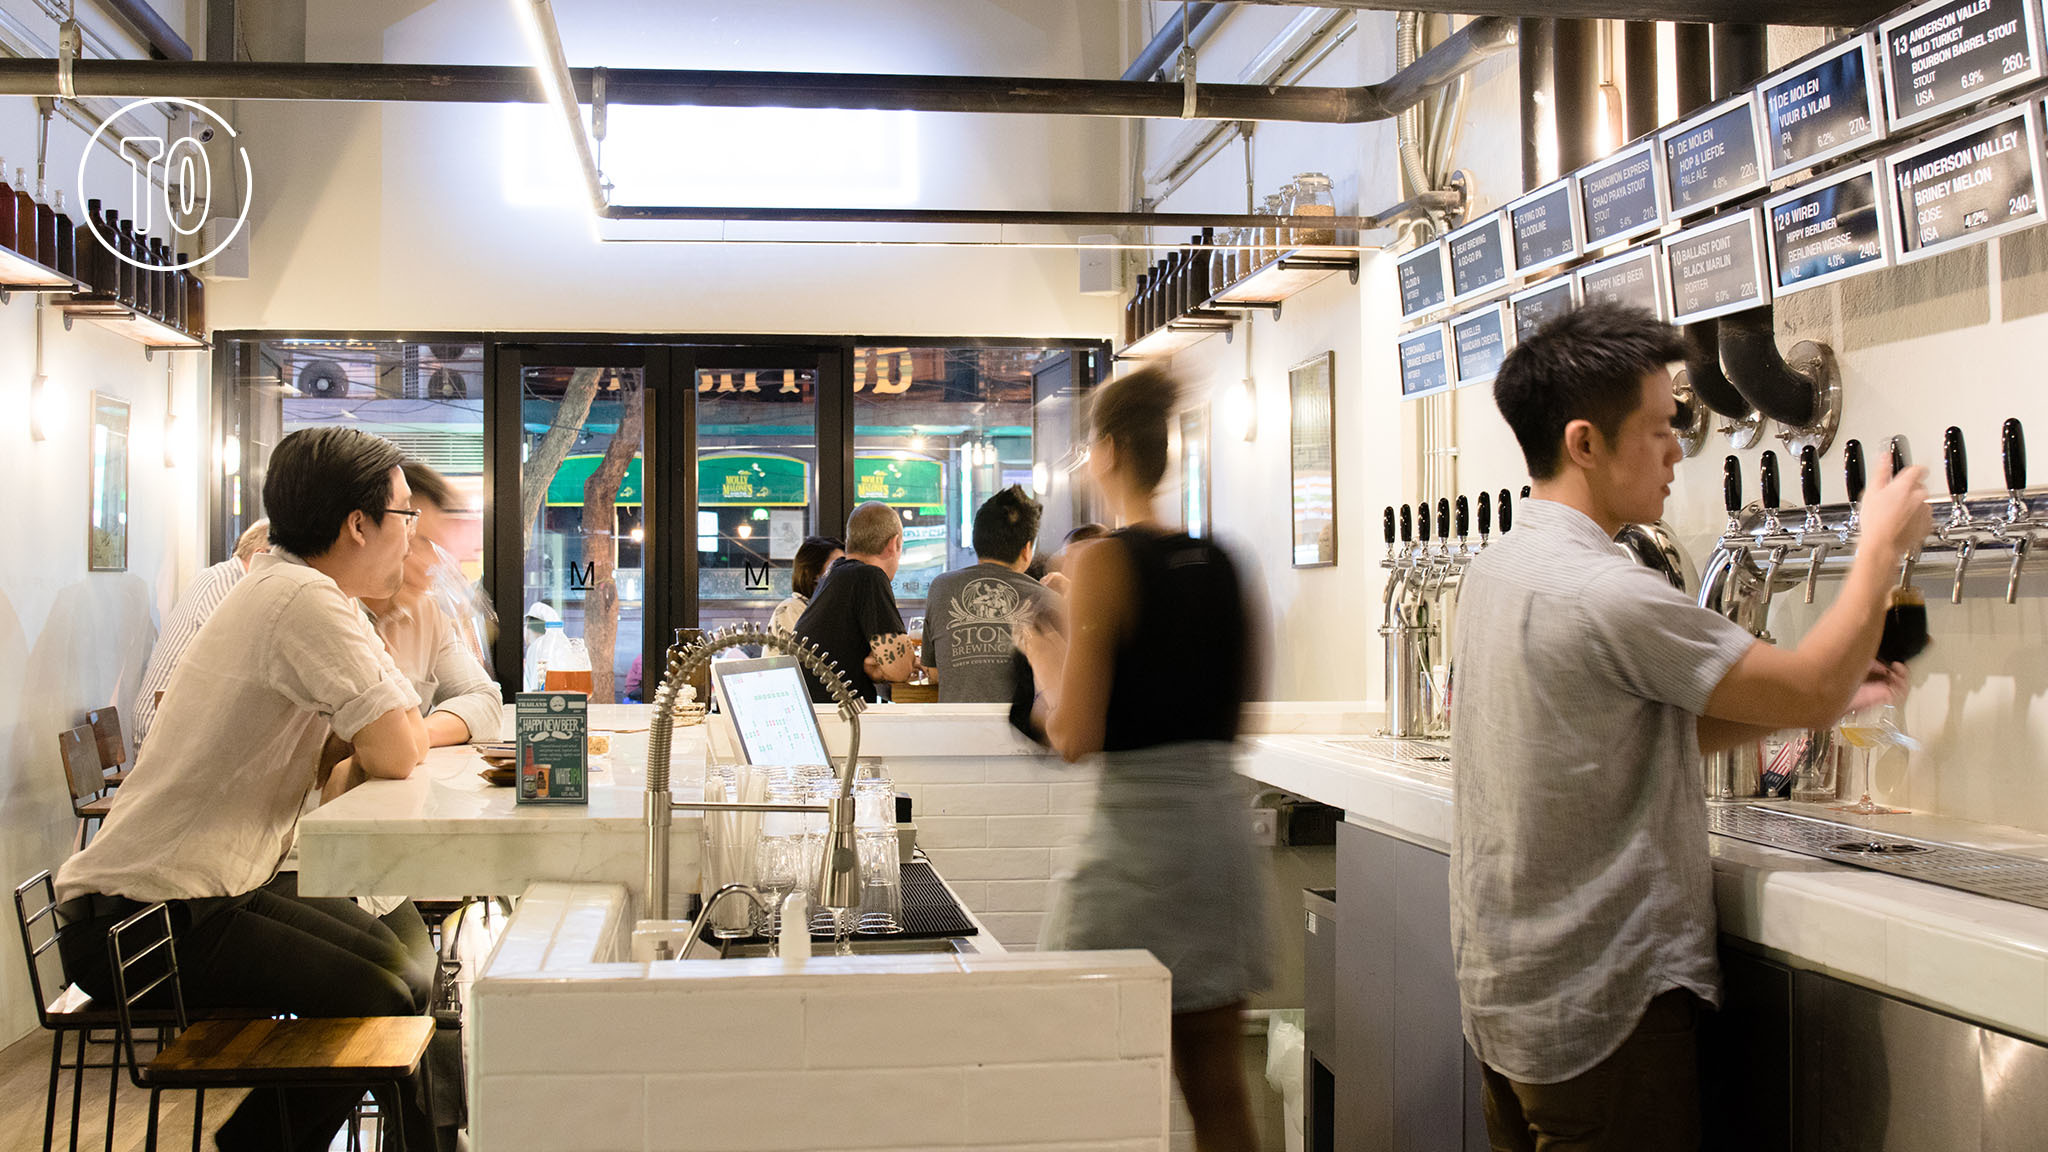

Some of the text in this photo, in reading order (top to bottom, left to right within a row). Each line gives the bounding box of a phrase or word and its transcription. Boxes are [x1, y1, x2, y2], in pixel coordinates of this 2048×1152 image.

[1893, 0, 1991, 56] 13 ANDERSON VALLEY
[1910, 26, 1963, 58] WILD TURKEY
[1912, 20, 2017, 74] BOURBON BARREL STOUT
[1914, 71, 1935, 88] STOUT
[1916, 89, 1934, 106] USA
[1961, 70, 1984, 88] 6.9%
[1769, 78, 1819, 113] 11 DE MOLEN
[1779, 95, 1831, 128] VUUR & VLAM
[1668, 128, 1714, 159] 9 DE MOLEN
[1781, 131, 1792, 145] IPA
[1783, 149, 1793, 160] NL
[1817, 132, 1835, 147] 6.2%
[1680, 143, 1725, 173] HOP & LIEFDE
[1898, 131, 2017, 191] 14 ANDERSON VALLEY
[1584, 160, 1650, 198] 7 CHANGWON EXPRESS
[1681, 167, 1708, 187] PALE ALE
[1915, 167, 1992, 207] BRINEY MELON
[1593, 177, 1645, 208] CHAO PRAYA STOUT
[1683, 191, 1691, 202] NL
[1514, 205, 1546, 229] 5 FLYING DOG
[1594, 208, 1610, 223] STOUT
[1792, 202, 1819, 223] WIRED
[1918, 206, 1942, 225] GOSE
[1521, 220, 1547, 238] BLOODLINE
[1786, 218, 1837, 243] HIPPY BERLINER
[1920, 228, 1939, 243] USA
[1965, 210, 1988, 227] 4.2%
[1452, 234, 1486, 259] 3 BEAT BREWING
[1672, 236, 1731, 267] 10 BALLAST POINT
[1788, 232, 1851, 263] BERLINER WEISSE
[1523, 255, 1532, 264] USA
[1683, 254, 1731, 278] BLACK MARLIN
[1791, 267, 1801, 279] NZ
[1828, 253, 1845, 268] 4.0%
[1592, 277, 1611, 291] HAPPY
[1612, 273, 1625, 287] NEW
[1627, 268, 1644, 282] BEER
[1685, 279, 1709, 294] PORTER
[1687, 298, 1699, 309] USA
[726, 476, 748, 484] MOLLY
[571, 561, 594, 586] M
[745, 561, 769, 586] M
[952, 626, 1012, 647] STON
[953, 644, 1006, 656] BREWING
[523, 719, 579, 731] HAPPY NEW BEER
